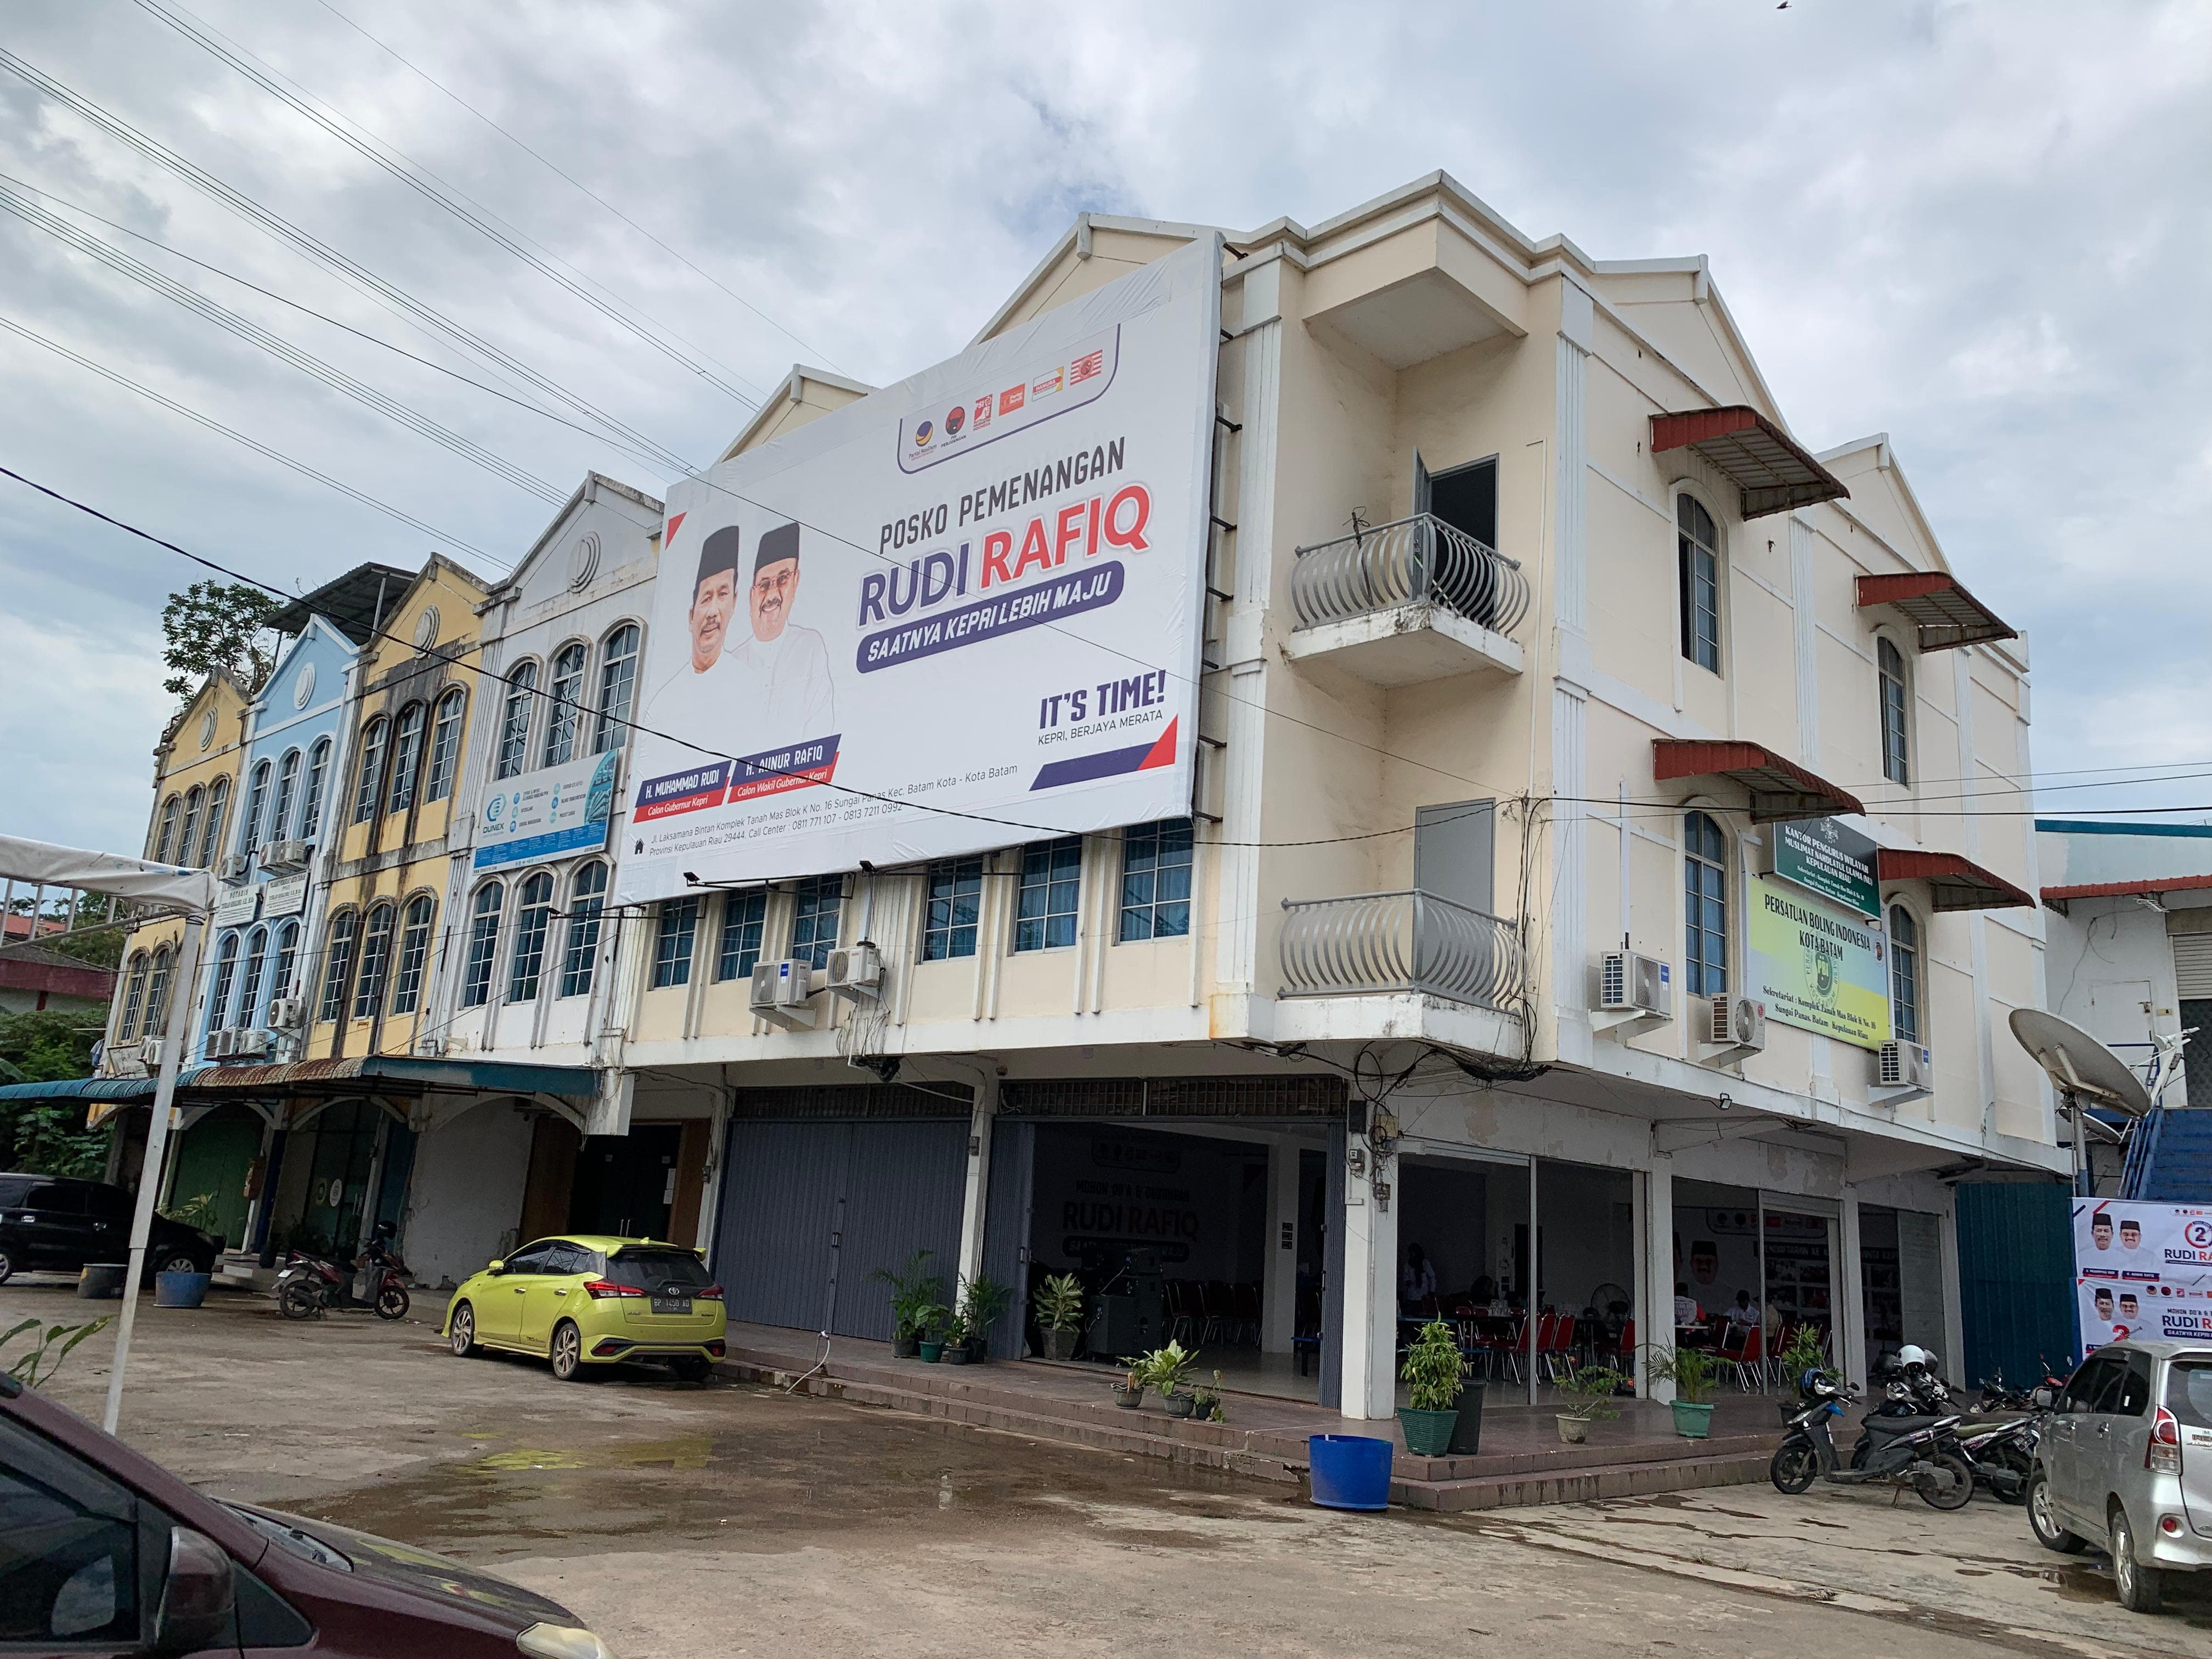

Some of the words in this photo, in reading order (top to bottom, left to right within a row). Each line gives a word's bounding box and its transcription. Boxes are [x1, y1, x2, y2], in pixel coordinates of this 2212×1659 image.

[1036, 379, 1056, 391] HANURA
[909, 448, 921, 459] Partai
[921, 444, 937, 455] NasDem
[941, 435, 966, 448] PERJUANGAN
[880, 504, 948, 555] POSKO
[959, 437, 1125, 527] PEMENANGAN
[859, 543, 969, 627] RUDI
[980, 485, 1150, 589] RAFIQ
[867, 623, 943, 662] SAATNYA
[944, 606, 997, 641] KEPRI
[998, 590, 1052, 625] LEBIH
[1052, 571, 1112, 610] MAJU
[1039, 690, 1087, 729] IT'S
[1097, 669, 1166, 716] TIME!
[1038, 730, 1068, 746] KEPRI,
[1070, 719, 1116, 739] BERJAYA
[1119, 710, 1163, 727] MERATA
[746, 761, 755, 776] H.
[758, 753, 790, 773] AUNUR
[794, 745, 823, 765] RAFIQ
[646, 785, 652, 799] H.
[655, 772, 698, 797] MUHAMMAD
[701, 769, 720, 787] RUDI
[737, 786, 756, 797] Calon
[757, 781, 775, 793] Wakil
[776, 775, 808, 789] Gubernur
[808, 769, 827, 783] Kepri
[648, 804, 663, 816] Calon
[664, 800, 691, 814] Gubernur
[692, 795, 708, 809] Kepri
[659, 829, 693, 842] Laksamana
[695, 825, 715, 836] Bintan
[716, 817, 745, 831] Komplek
[747, 814, 768, 825] Tanah
[769, 810, 783, 820] Mas
[785, 807, 801, 817] Blok
[803, 805, 808, 814] K
[810, 803, 822, 813] No.
[825, 800, 832, 810] 16
[834, 796, 860, 808] Sungai
[862, 791, 885, 803] Panas
[888, 787, 905, 798] Kec.
[907, 781, 934, 794] Batam
[936, 775, 956, 788] Kota
[965, 770, 986, 783] Kota
[989, 765, 1018, 778] Batam
[650, 845, 673, 856] Provinsi
[674, 838, 707, 853] Kepulauan
[708, 836, 722, 846] Riau
[749, 827, 761, 838] Call
[763, 824, 786, 836] Center
[792, 819, 808, 830] 0811
[810, 816, 822, 827] 771
[823, 814, 837, 825] 107
[844, 809, 862, 821] 0813
[864, 806, 879, 817] 7211
[882, 802, 902, 814] 0992
[1785, 825, 1812, 845] KANTOR
[1813, 838, 1843, 861] PENGURUS
[1844, 854, 1869, 874] WILAYAH
[1785, 837, 1814, 856] MUSLIMAT
[1815, 851, 1846, 872] NAHDLATUL
[1846, 865, 1863, 881] ULAMA
[1806, 856, 1838, 878] KEPULAUAN
[1838, 871, 1852, 884] RIAU
[229, 889, 249, 899] NOTARIS
[1765, 894, 1808, 926] PERSATUAN
[1809, 912, 1835, 936] BOLING
[1836, 923, 1871, 951] INDONESIA
[1799, 930, 1819, 951] KOTA
[1820, 938, 1843, 961] BATAM
[1818, 959, 1829, 977] PBI
[1763, 985, 1793, 1003] Sekretariat
[1798, 996, 1820, 1011] Komplek
[1821, 1004, 1836, 1016] Tanah
[1837, 1009, 1846, 1019] Mas
[1847, 1013, 1858, 1023] Blok
[1775, 1003, 1793, 1016] Sungai
[1812, 1014, 1829, 1027] Batam
[1832, 1021, 1857, 1036] Kepulauan
[1858, 1029, 1869, 1040] Riau
[1063, 1201, 1122, 1232] RUDI
[1128, 1207, 1199, 1243] RAFIQ
[2195, 1227, 2207, 1242] 2
[2164, 1249, 2196, 1260] RUDI
[2162, 1315, 2198, 1329] RUDI
